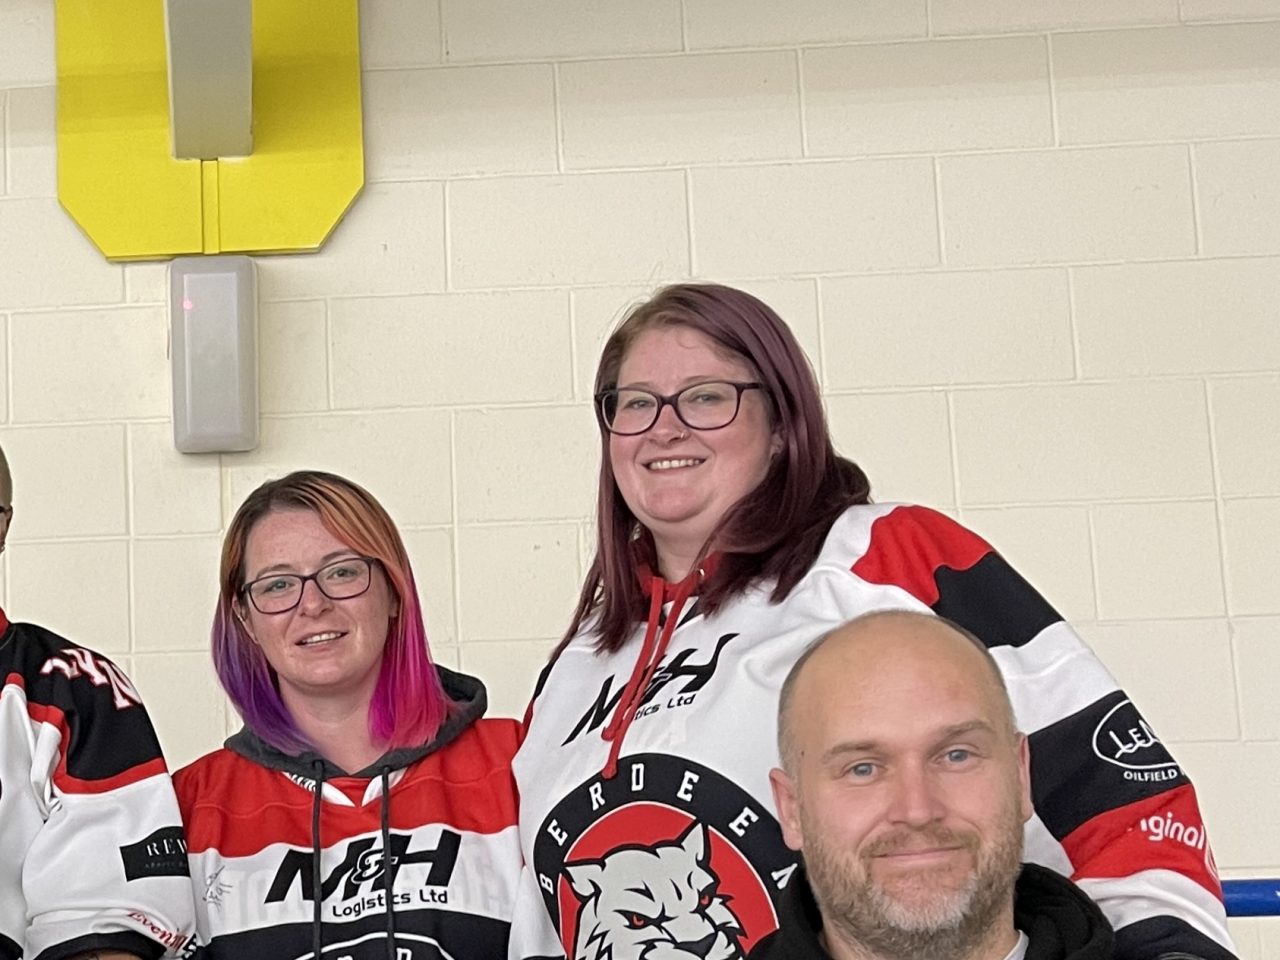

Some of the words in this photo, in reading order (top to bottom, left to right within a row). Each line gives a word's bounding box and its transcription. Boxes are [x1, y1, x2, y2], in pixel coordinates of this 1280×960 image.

[561, 633, 740, 747] MH
[667, 694, 696, 710] Ltd
[1123, 770, 1179, 783] OILFIELD
[264, 829, 462, 904] M&H
[332, 890, 411, 918] Logistcs
[419, 889, 448, 904] Ltd
